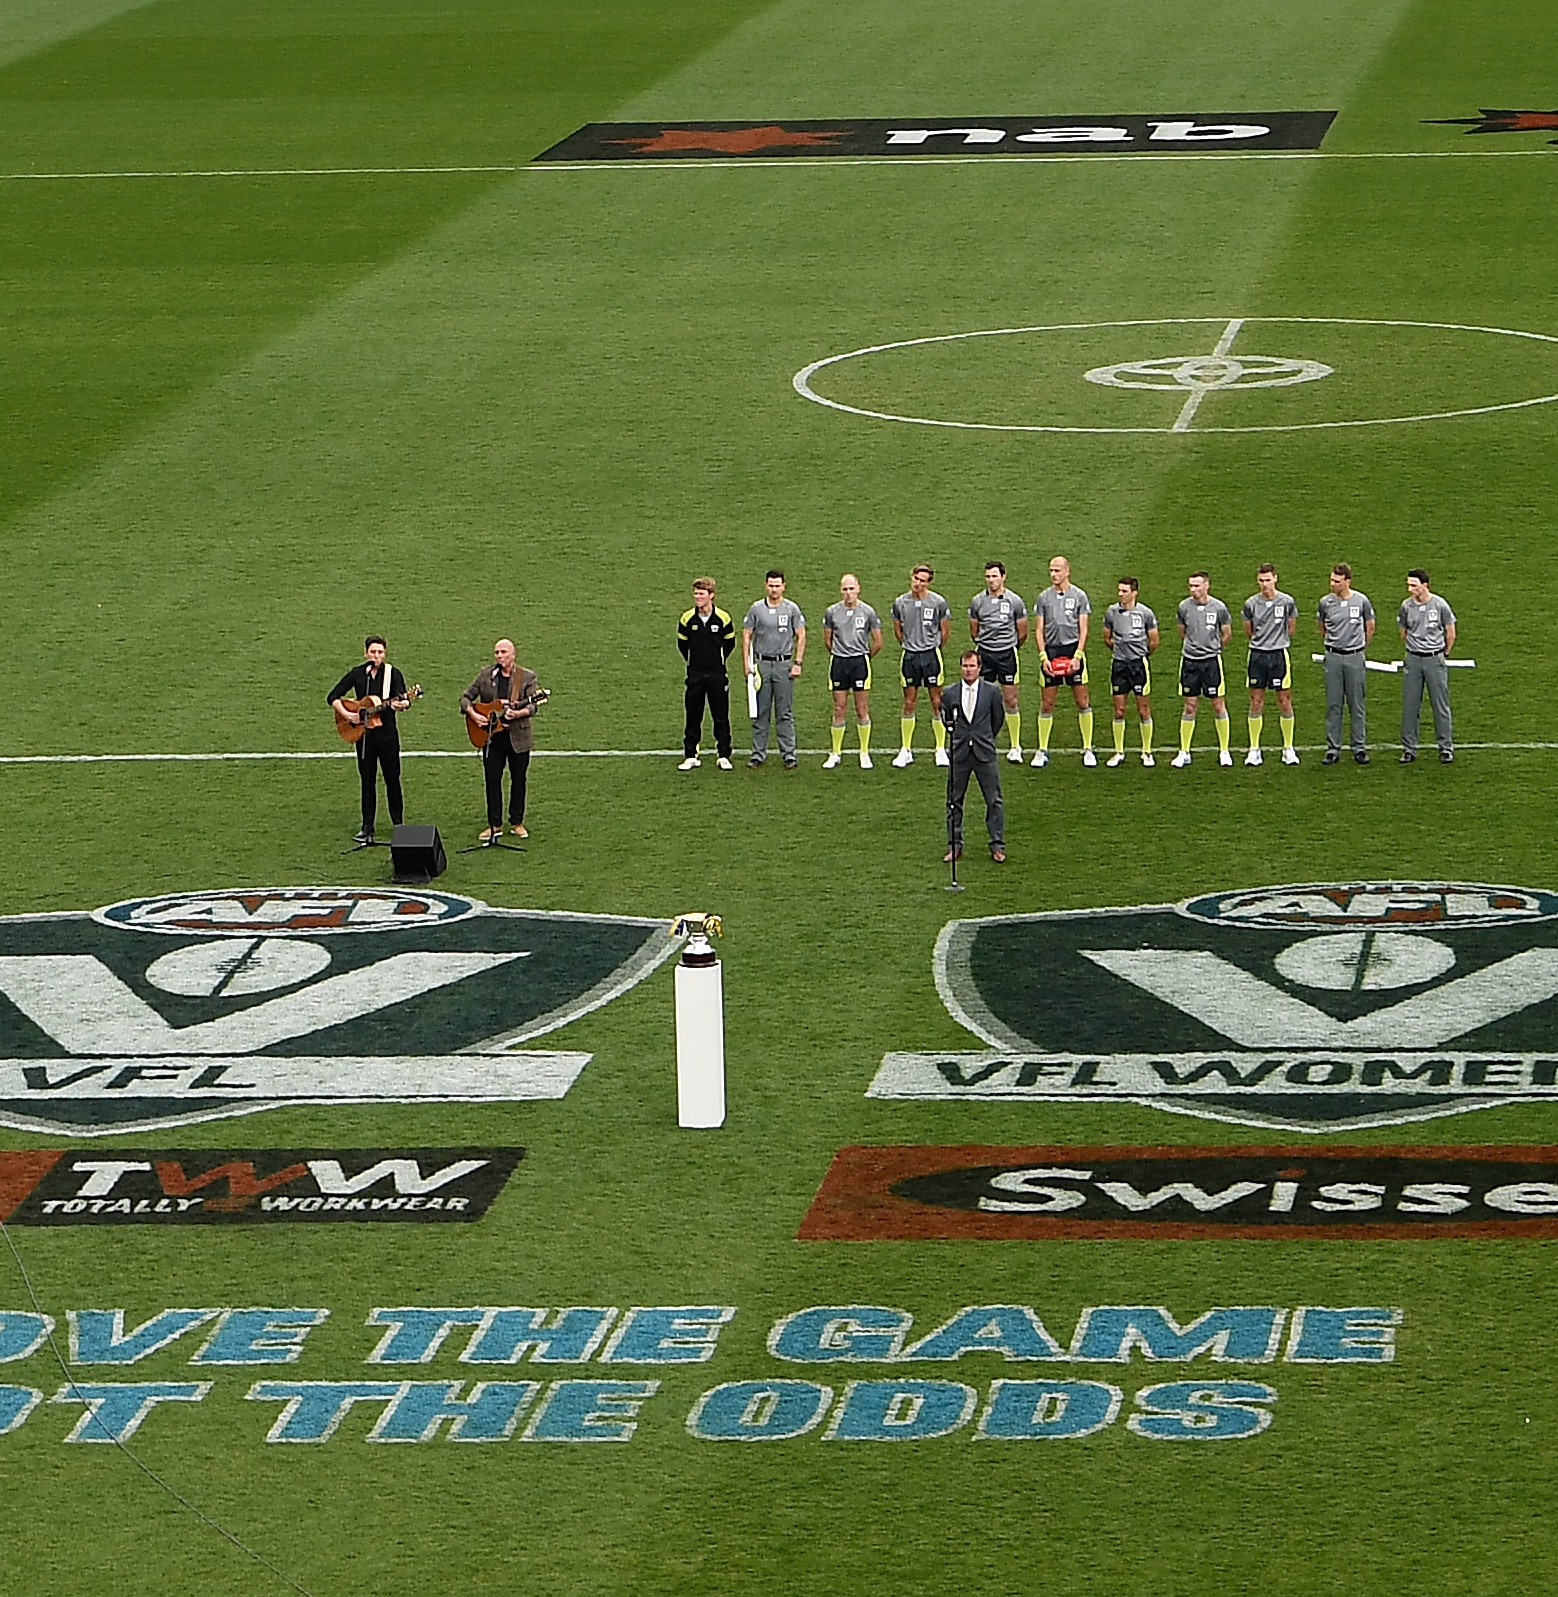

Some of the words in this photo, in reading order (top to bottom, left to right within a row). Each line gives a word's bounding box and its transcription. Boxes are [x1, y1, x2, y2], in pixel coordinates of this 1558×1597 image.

[885, 120, 1270, 146] nab
[21, 1064, 258, 1092] VFL
[936, 1060, 1125, 1089] VFL
[41, 1198, 204, 1213] TOTALLY
[260, 1195, 471, 1212] WORKWEAR
[363, 1307, 731, 1366] THE
[766, 1307, 1401, 1364] GAME
[245, 1381, 672, 1444] THE
[686, 1380, 1276, 1440] ODDS
